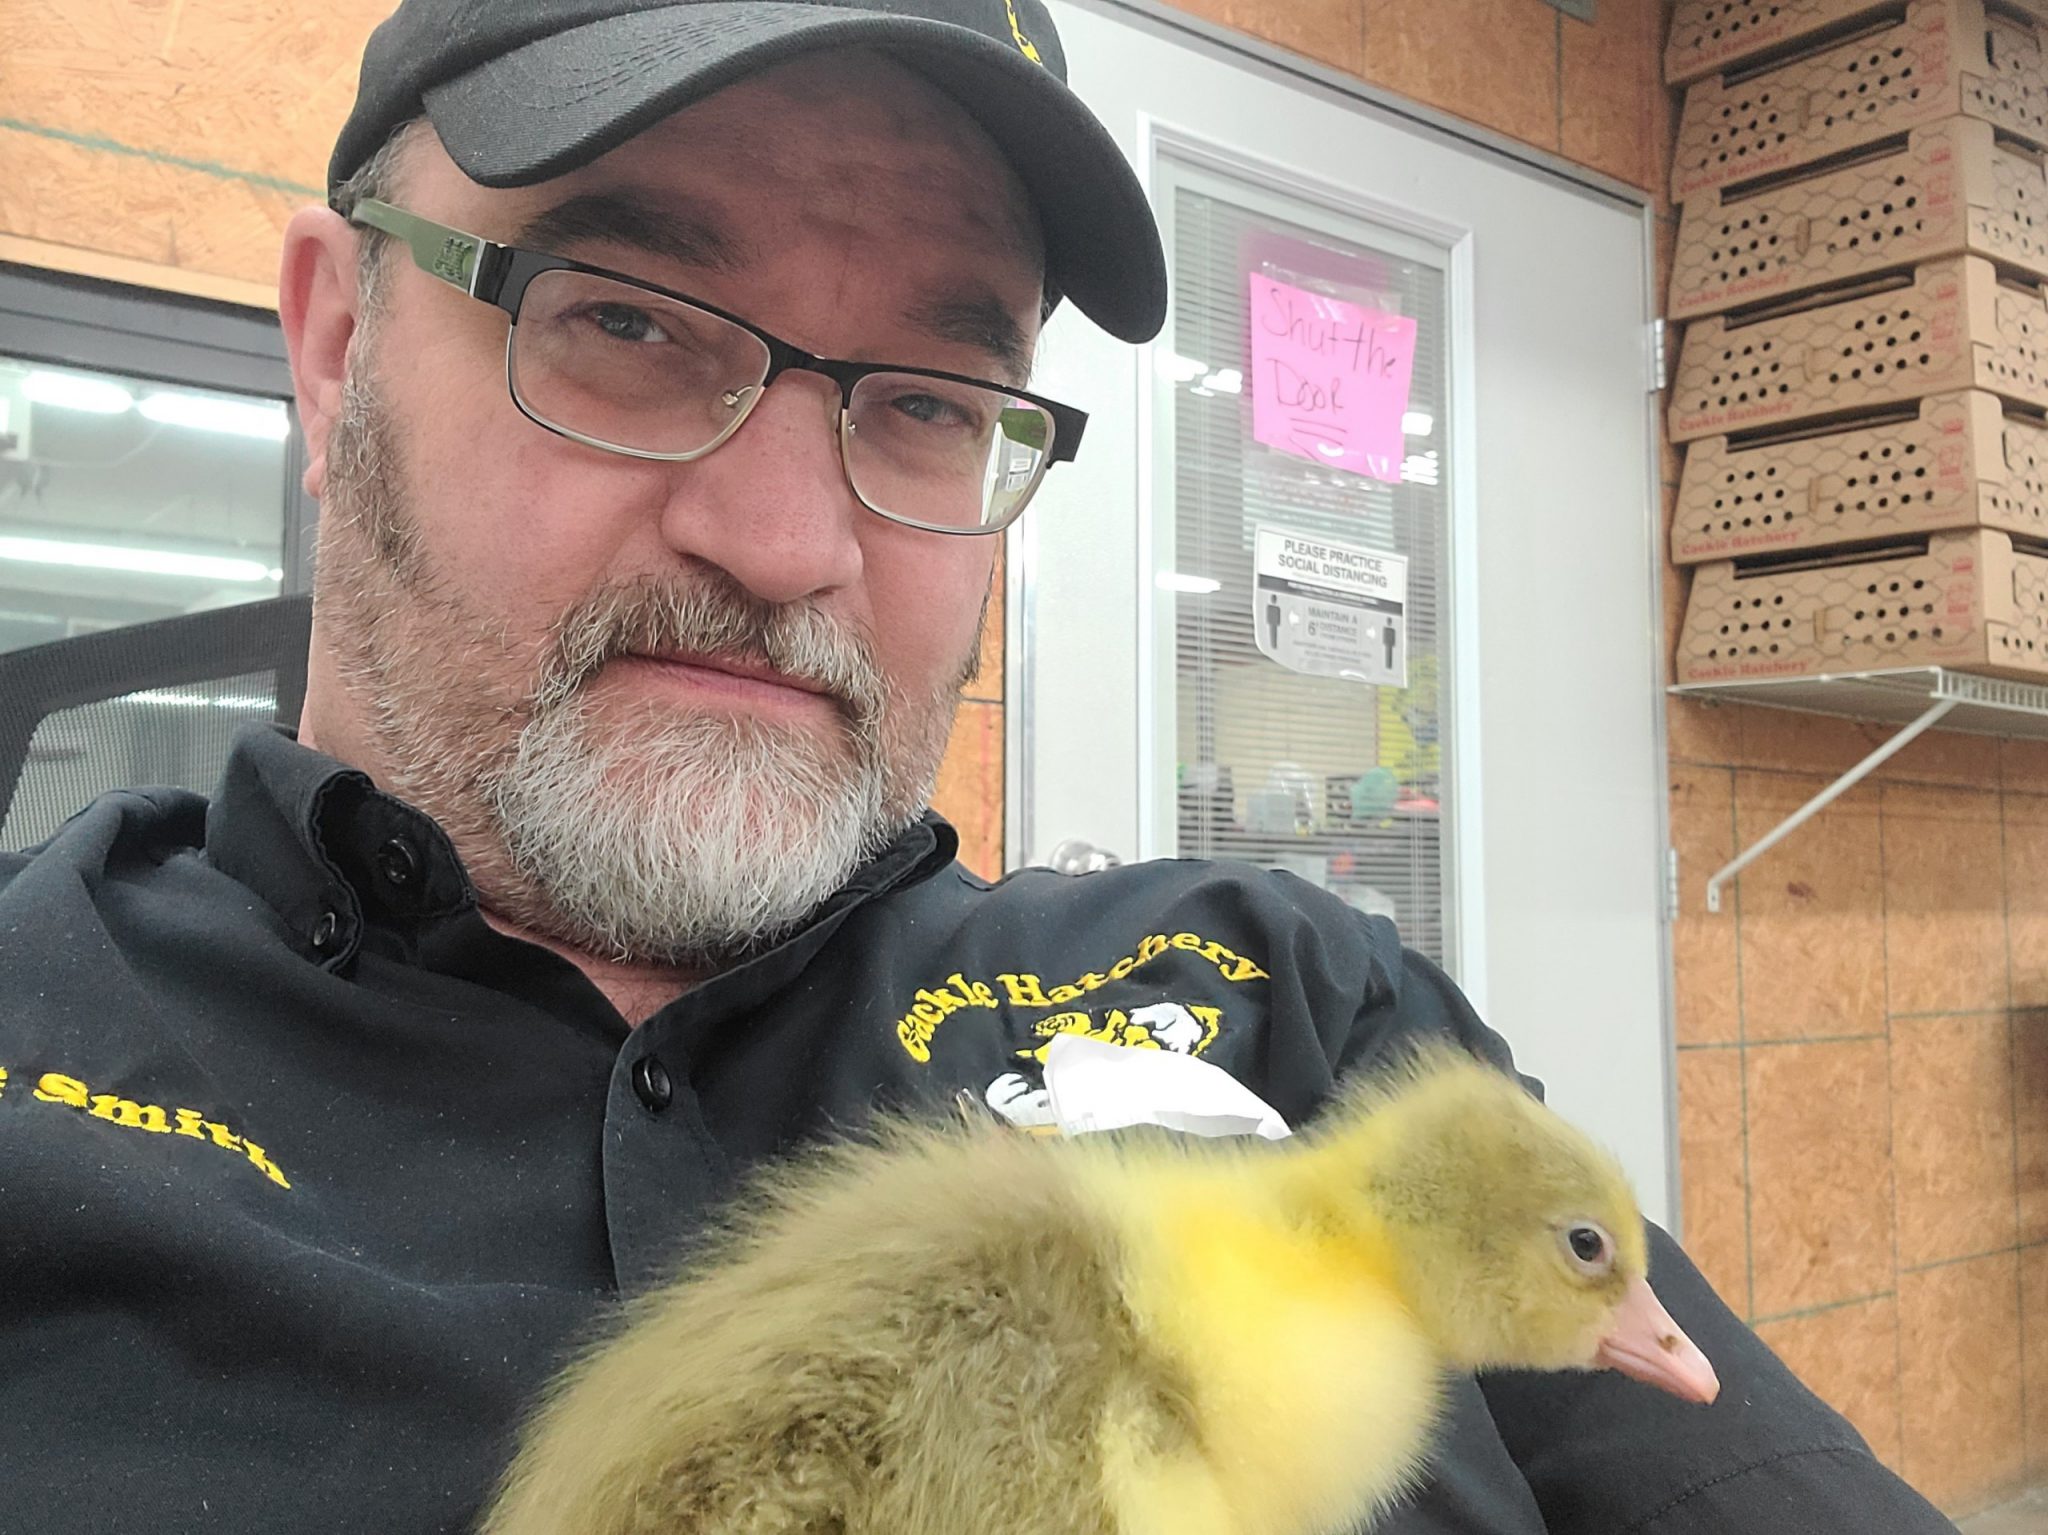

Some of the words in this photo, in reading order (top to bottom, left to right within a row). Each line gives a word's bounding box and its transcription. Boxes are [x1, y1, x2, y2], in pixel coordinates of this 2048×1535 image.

[1262, 288, 1340, 355] Shut
[1278, 554, 1320, 574] SOCIAL
[1323, 564, 1387, 588] DISTANCING
[1284, 539, 1327, 560] PLEASE
[1329, 550, 1383, 572] PRACTICE
[897, 973, 999, 1063] Cackle
